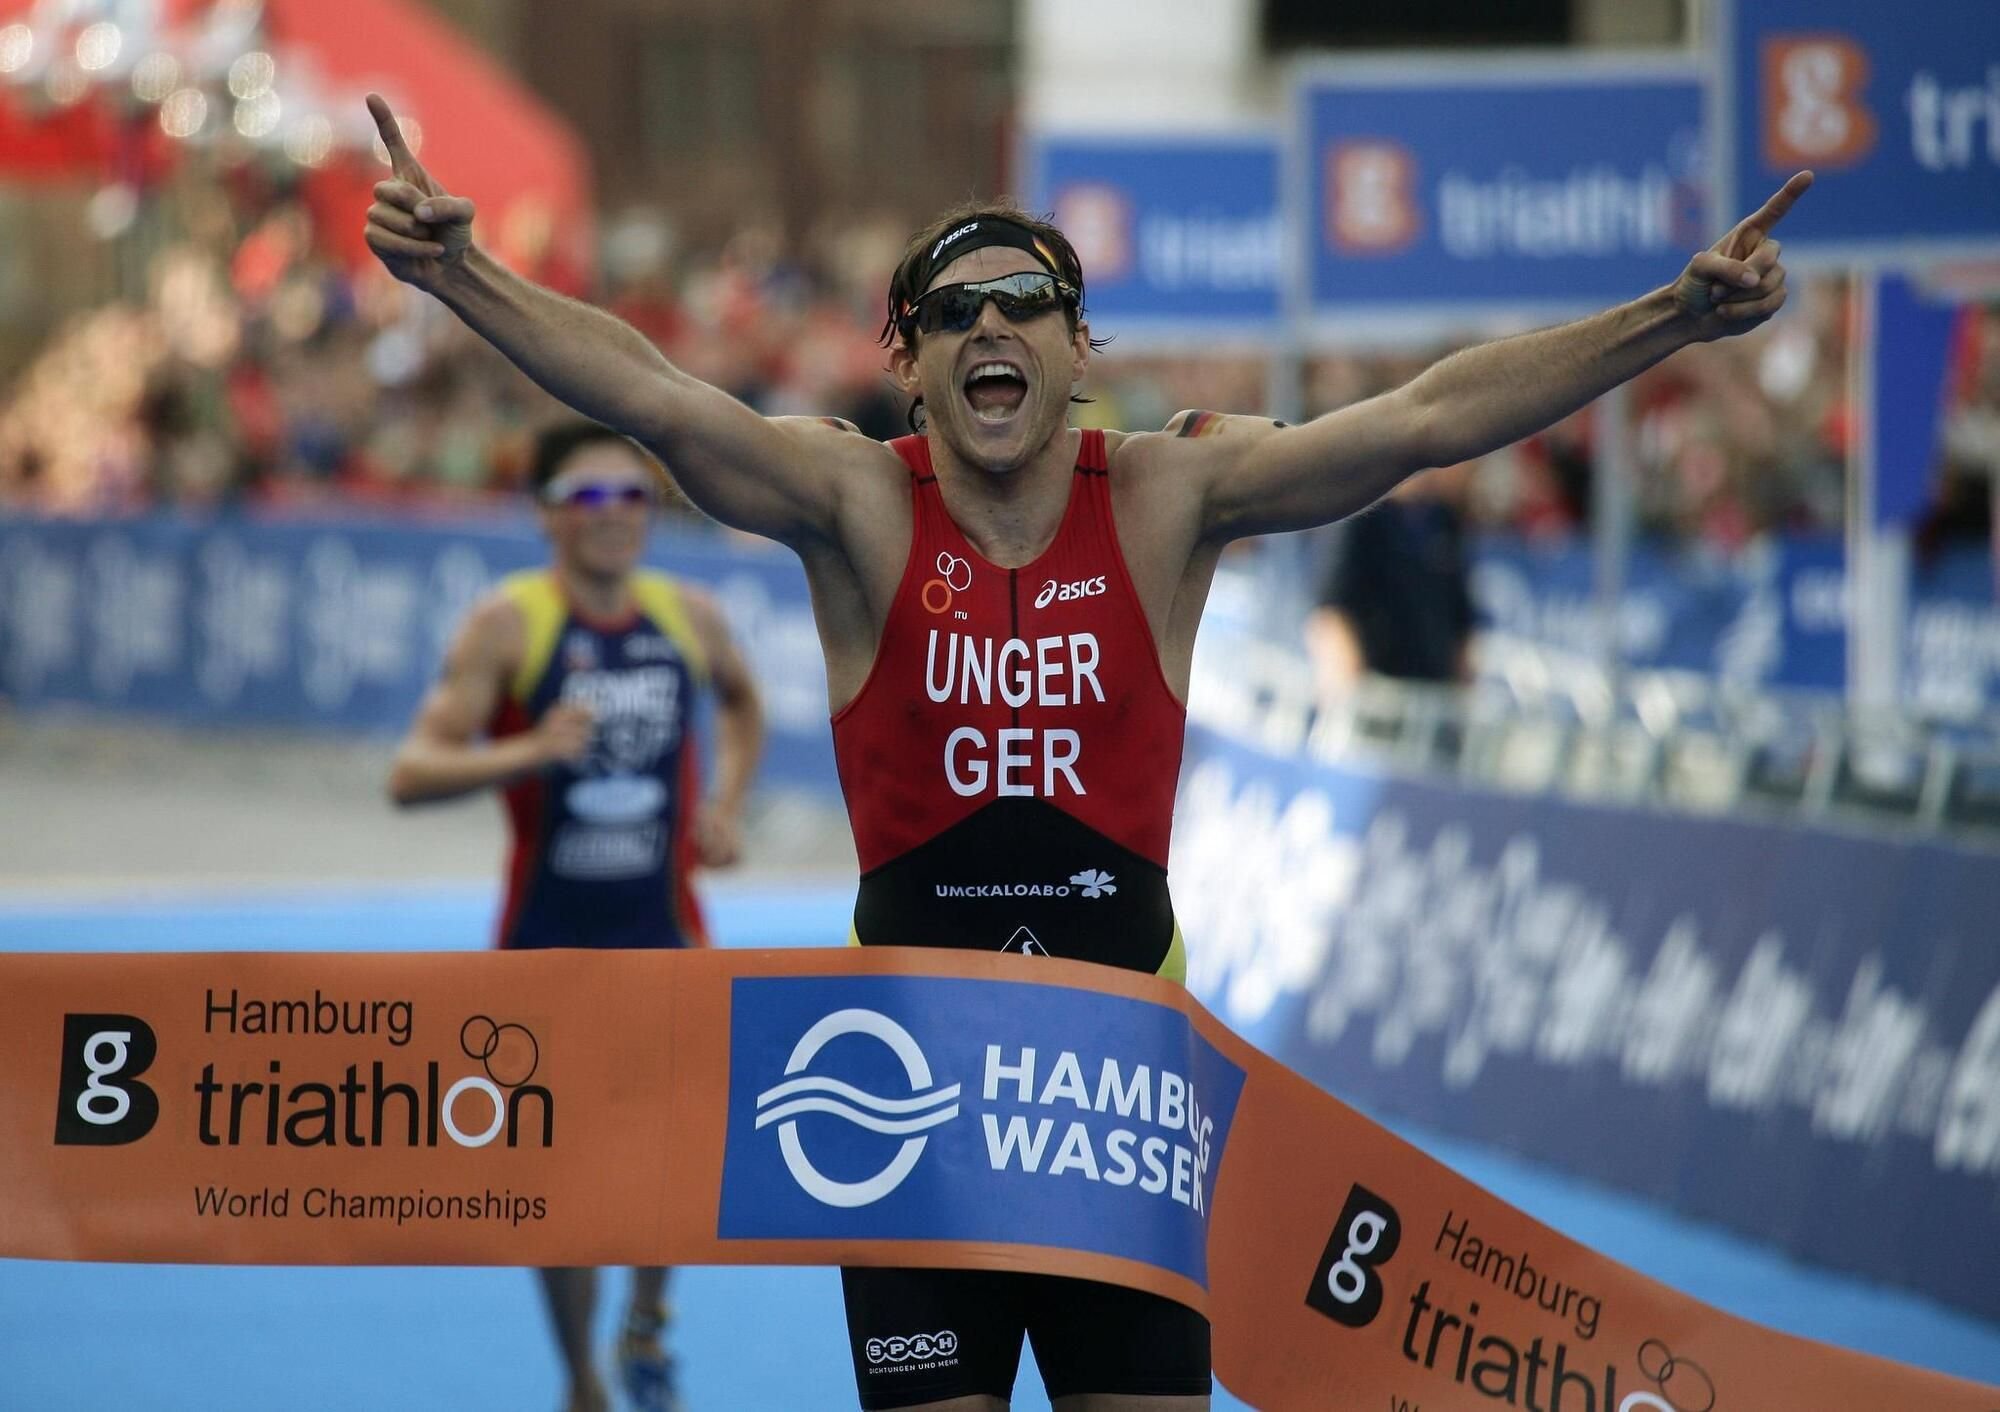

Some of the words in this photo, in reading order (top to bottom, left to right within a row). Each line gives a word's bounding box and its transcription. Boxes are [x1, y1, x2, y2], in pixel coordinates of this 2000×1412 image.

[954, 610, 968, 620] ITU
[925, 629, 1106, 708] UNGER
[943, 726, 1087, 797] GER
[935, 884, 1070, 897] UMCKALOABO
[204, 989, 415, 1046] Hamburg
[194, 1060, 554, 1148] triathlon
[982, 1044, 1214, 1175] HAMBUG
[193, 1187, 290, 1218] World
[302, 1189, 547, 1227] Championships
[1434, 1210, 1602, 1340] Hamburg
[868, 1364, 916, 1375] DICHTUNGEN
[918, 1362, 936, 1371] UND
[938, 1358, 959, 1368] MEHR
[869, 1337, 954, 1357] SPÄH
